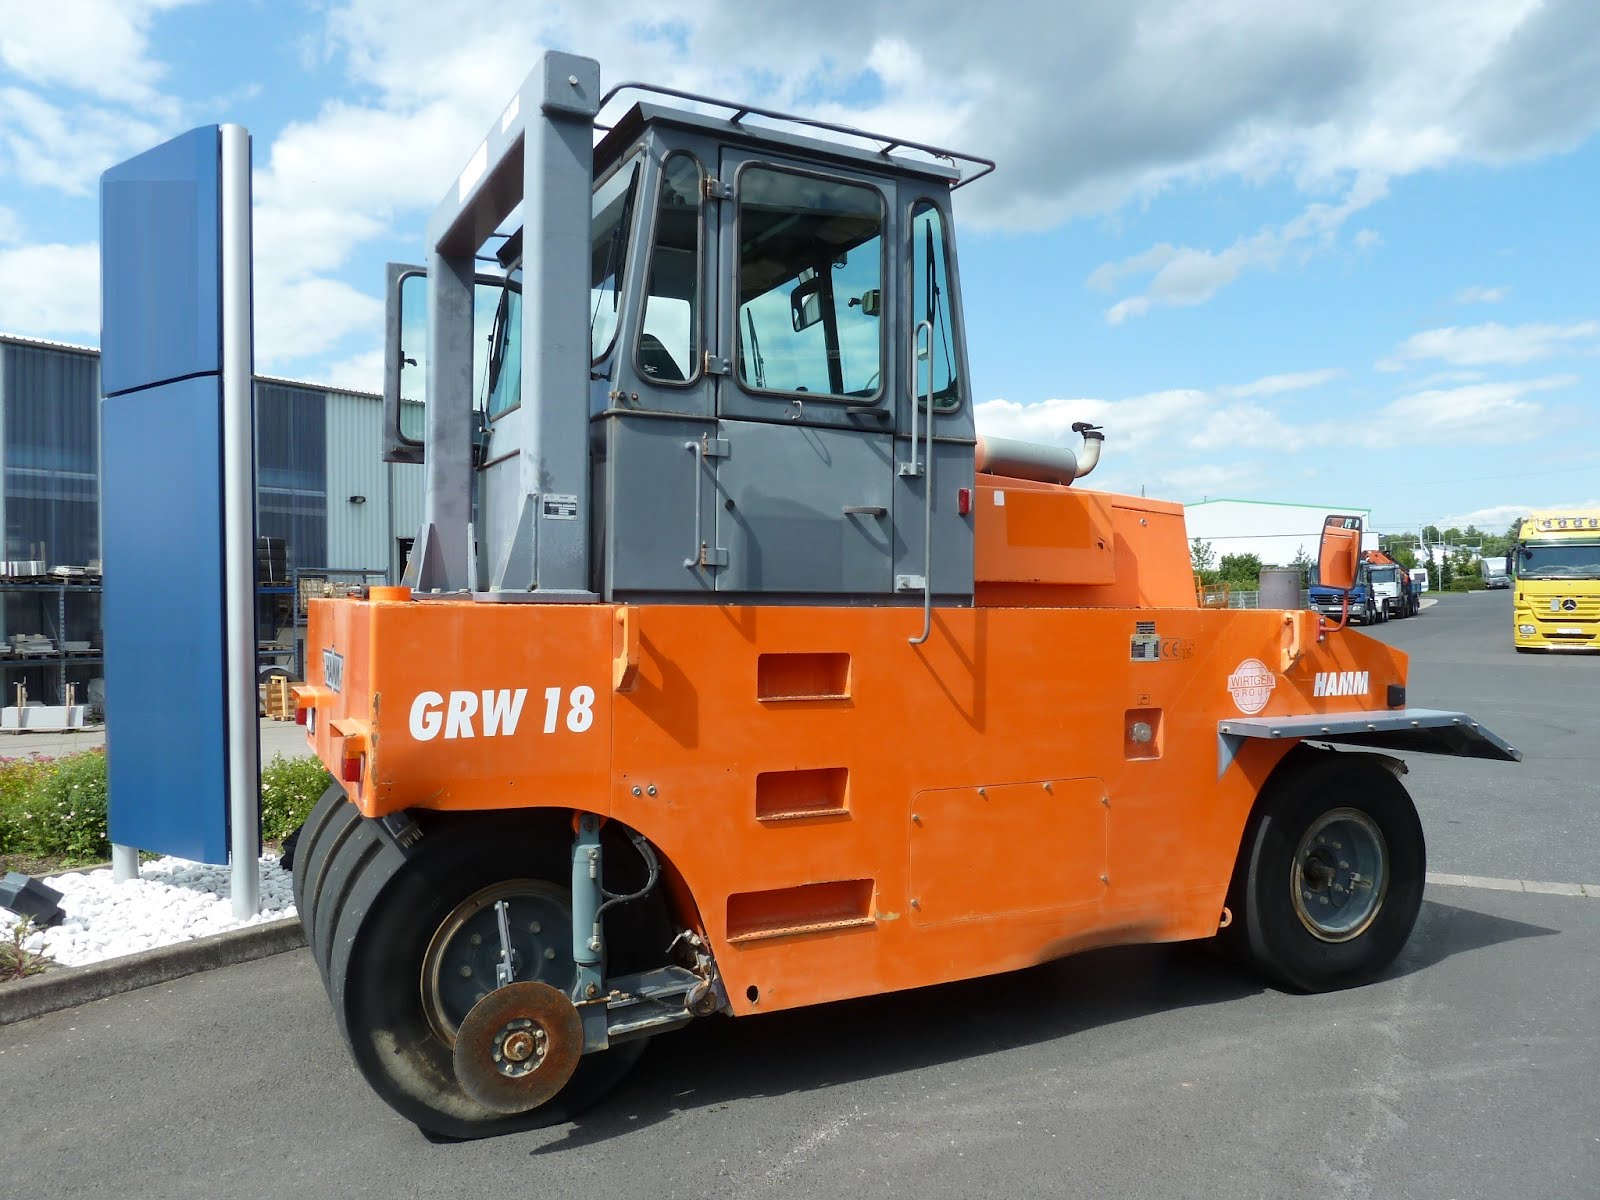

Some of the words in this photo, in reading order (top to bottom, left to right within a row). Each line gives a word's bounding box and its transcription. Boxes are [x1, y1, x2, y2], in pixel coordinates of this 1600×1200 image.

[1230, 674, 1274, 688] WIRTGEN
[1313, 671, 1369, 697] HAMM
[1233, 687, 1271, 698] GROUP
[408, 688, 529, 742] GRW
[543, 685, 596, 734] 18
